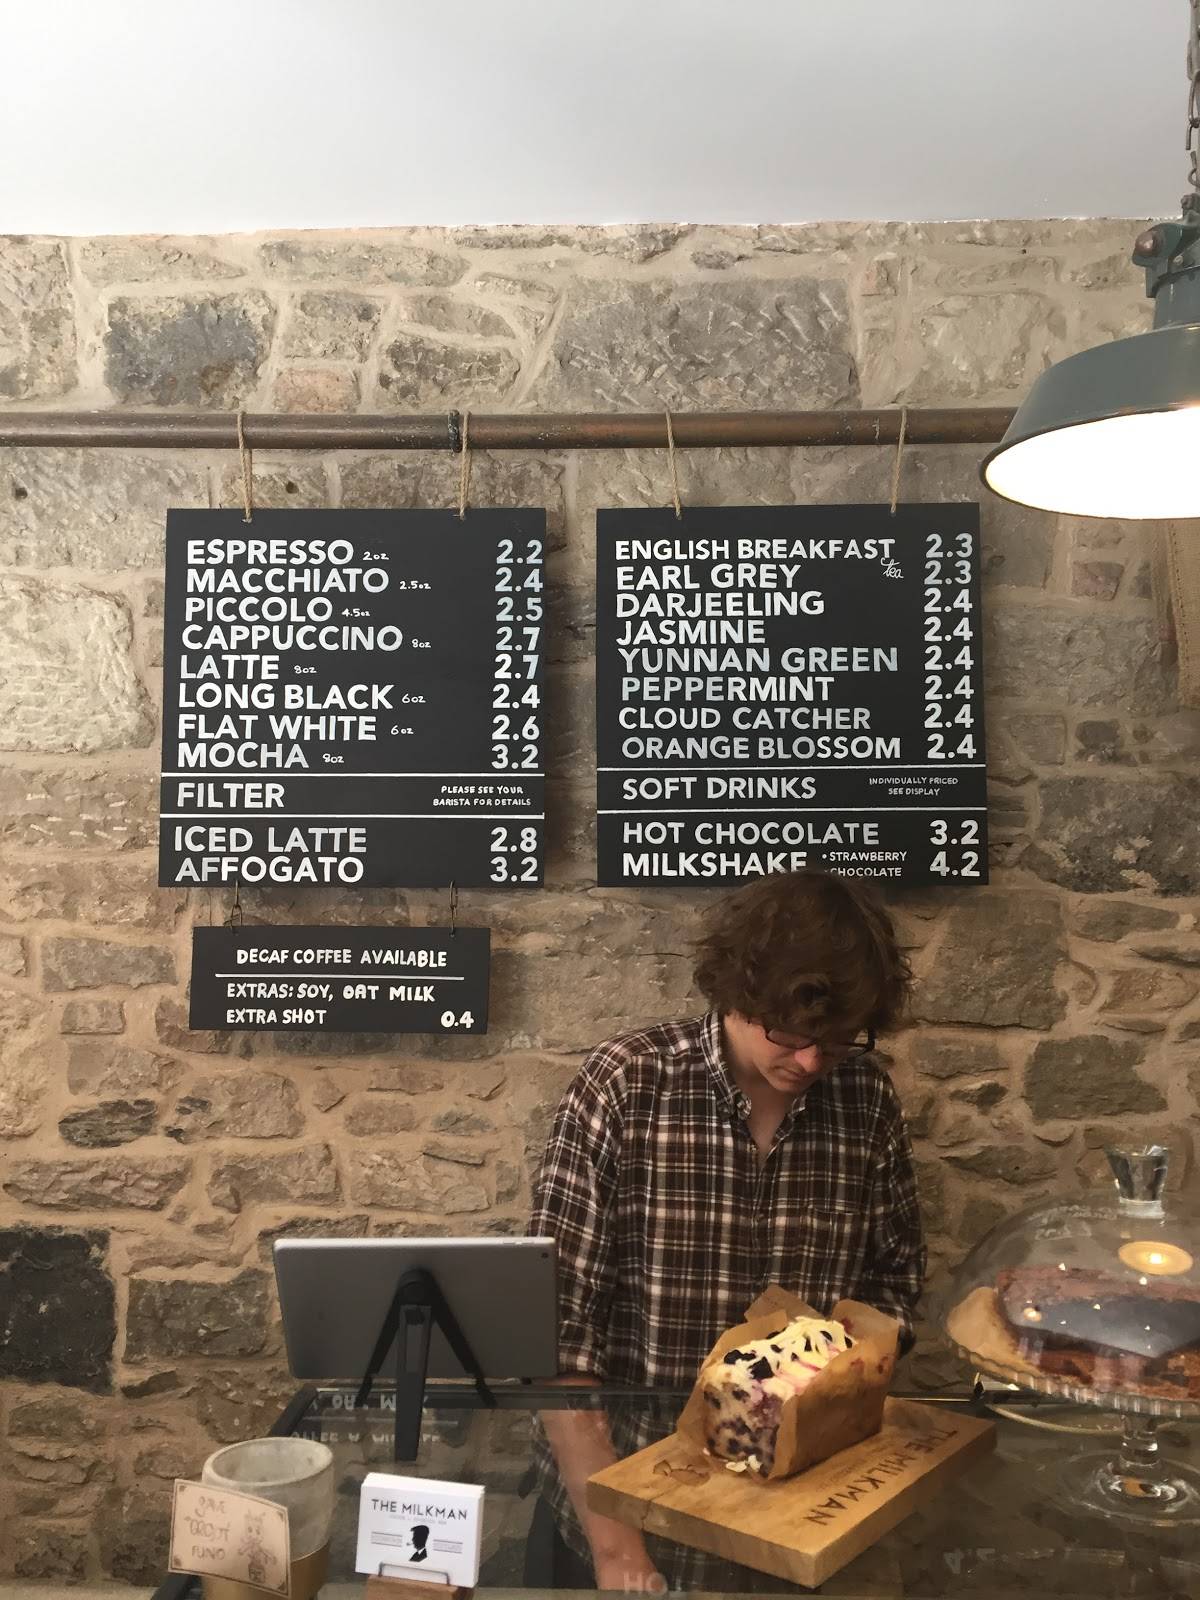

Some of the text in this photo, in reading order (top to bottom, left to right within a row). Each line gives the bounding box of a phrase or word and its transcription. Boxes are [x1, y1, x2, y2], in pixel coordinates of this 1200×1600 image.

[187, 539, 543, 565] ESPRESSO 2oz 2.2
[615, 533, 973, 560] ENGLISH BREAKFAST 2.3
[187, 568, 543, 593] MACCHIATO 2.5oz 2.4
[616, 560, 972, 590] EARL GREY 2.3
[881, 557, 904, 579] tea
[185, 597, 333, 622] PICCOLO
[496, 597, 543, 622] 2.5
[616, 588, 972, 618] DARJEELING 2.4
[181, 625, 540, 651] CAPPUCCINO 8oz 2.7
[616, 617, 973, 646] JASMINE 2.4
[180, 654, 280, 680] LATTE
[494, 654, 540, 680] 2.7
[618, 646, 974, 673] YUNNAN GREEN 2.4
[178, 683, 275, 709] LONG
[284, 684, 394, 710] BLACK
[492, 685, 541, 709] 2.4
[621, 676, 974, 701] PEPPERMINT 2.4
[178, 714, 258, 740] FLAT
[269, 715, 377, 741] WHITE
[491, 715, 540, 740] 2.6
[619, 704, 974, 730] CLOUD CATCHER 2.4
[178, 743, 309, 768] MOCHA
[491, 744, 539, 769] 3.2
[621, 734, 977, 760] ORANGE BLOSSOM 2.4
[441, 785, 524, 795] PLEASE SEE YOUR
[622, 777, 817, 800] SOFT DRINKS
[869, 777, 927, 785] INDIVIDUALLY
[906, 788, 940, 796] DISPLAY
[177, 783, 284, 808] FILTER
[433, 798, 531, 807] BARISTA FOR DETAILS
[174, 826, 538, 853] ICED LATTE 2.8
[623, 820, 979, 845] HOT CHOCOLATE 3.2
[830, 851, 907, 862] STRAWBERRY
[930, 851, 980, 877] 4.2
[175, 856, 539, 883] AFFOGATO 3.2
[237, 948, 447, 968] DECAF COFFEE AVAILABLE
[227, 983, 435, 1001] EXTRAS: SOY, OAT MILK
[226, 1009, 474, 1028] EXTRA SHOT 0.4
[904, 1430, 958, 1453] THE
[803, 1451, 916, 1526] MILKMAN
[371, 1499, 397, 1512] THE
[402, 1503, 468, 1520] MILKMAN
